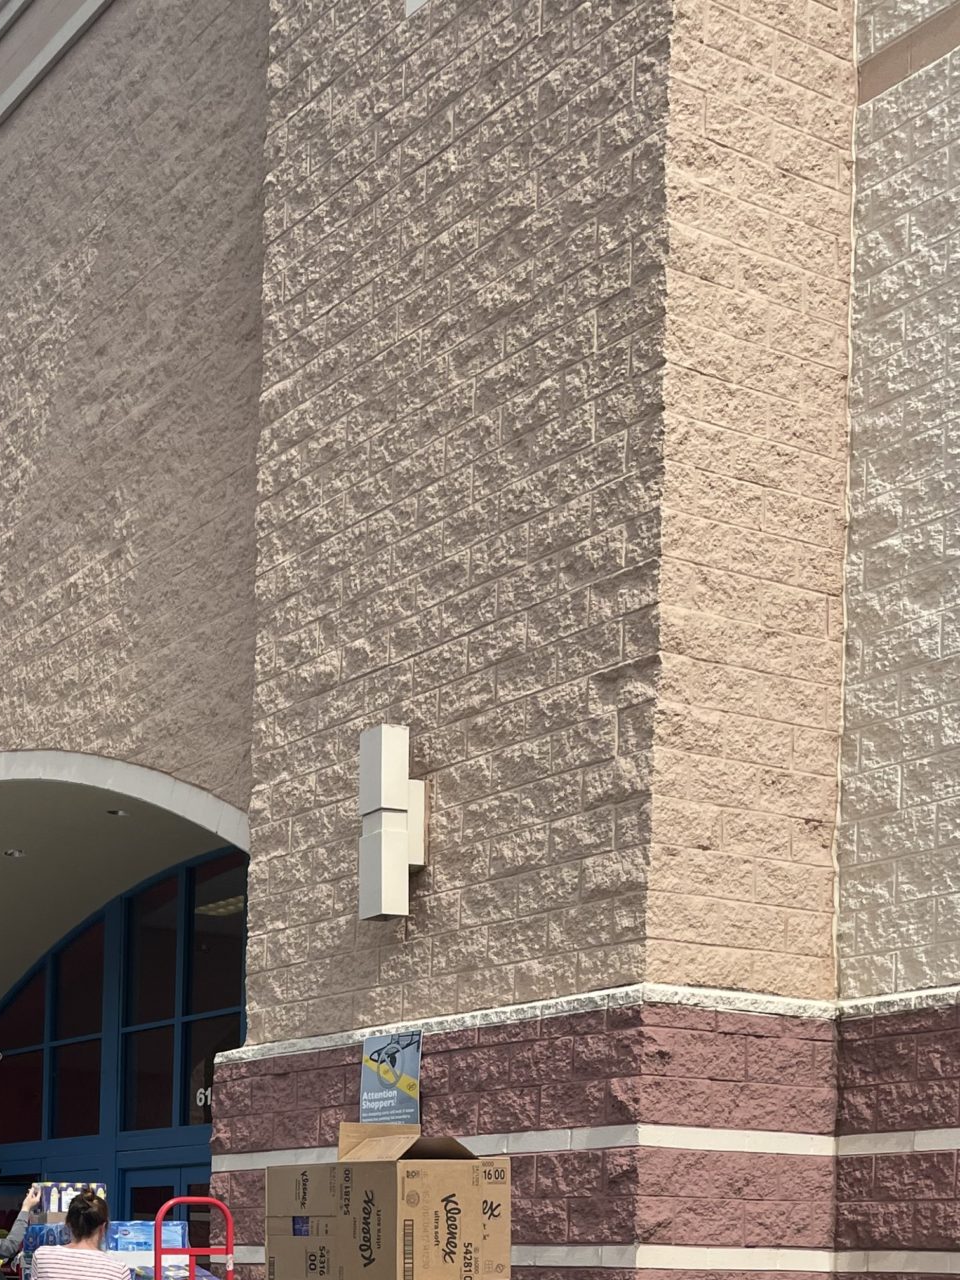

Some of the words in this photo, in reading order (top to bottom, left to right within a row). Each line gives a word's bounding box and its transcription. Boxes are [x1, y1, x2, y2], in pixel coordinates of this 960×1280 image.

[362, 1090, 398, 1100] Attention
[361, 1100, 397, 1110] Shoppers!
[344, 1169, 351, 1182] 00
[494, 1169, 505, 1180] 00
[300, 1170, 309, 1209] Kleenex
[359, 1189, 376, 1267] Kleenex
[441, 1193, 461, 1264] Kleenex
[308, 1254, 317, 1271] 00
[463, 1242, 473, 1273] 54281
